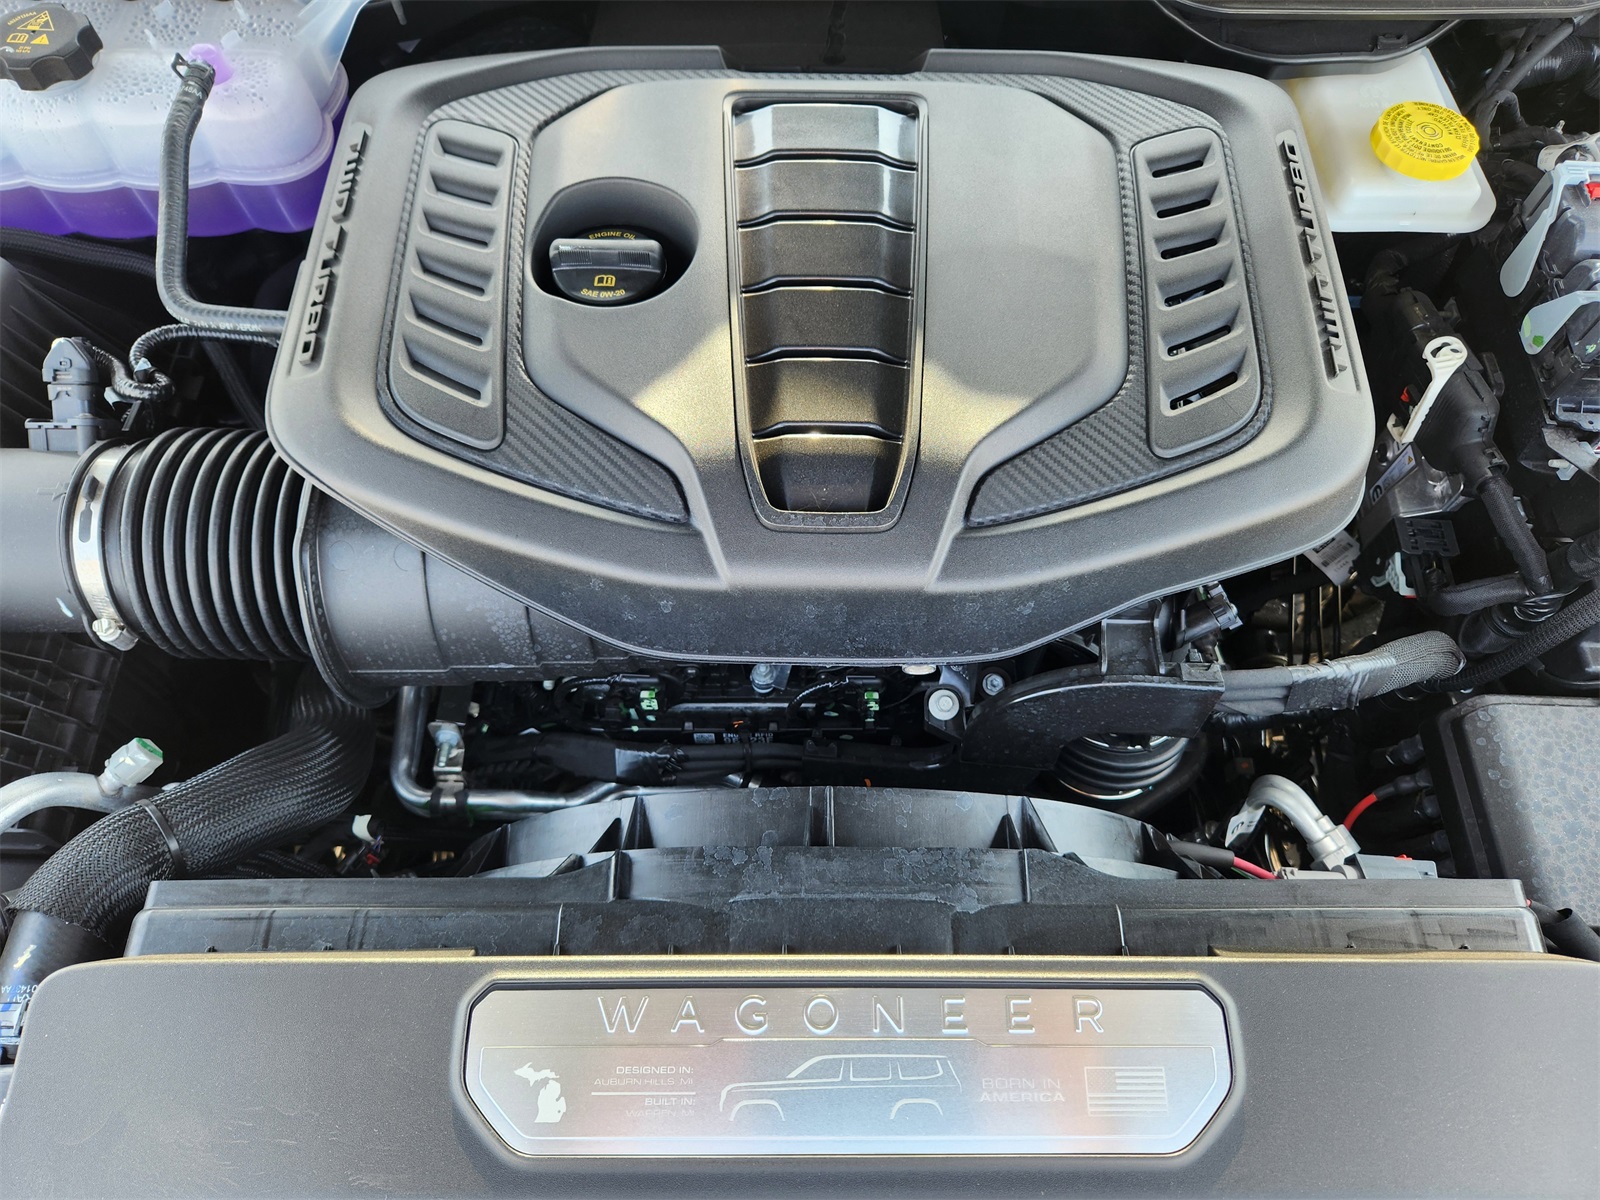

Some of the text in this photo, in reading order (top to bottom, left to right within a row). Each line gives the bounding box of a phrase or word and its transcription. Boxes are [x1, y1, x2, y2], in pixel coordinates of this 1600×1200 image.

[588, 231, 636, 240] ENGINE OIL
[299, 129, 369, 366] TWIN TURBO
[1282, 137, 1348, 378] TWIN TURBO
[580, 288, 626, 298] SAE 0W-20
[598, 994, 1104, 1035] WAGONEER
[616, 1066, 694, 1074] DESIGNED IN:
[594, 1078, 642, 1086] AUBURN
[982, 1078, 1061, 1089] BORN IN
[644, 1098, 696, 1106] BUILT IN:
[980, 1092, 1065, 1102] AMERICA
